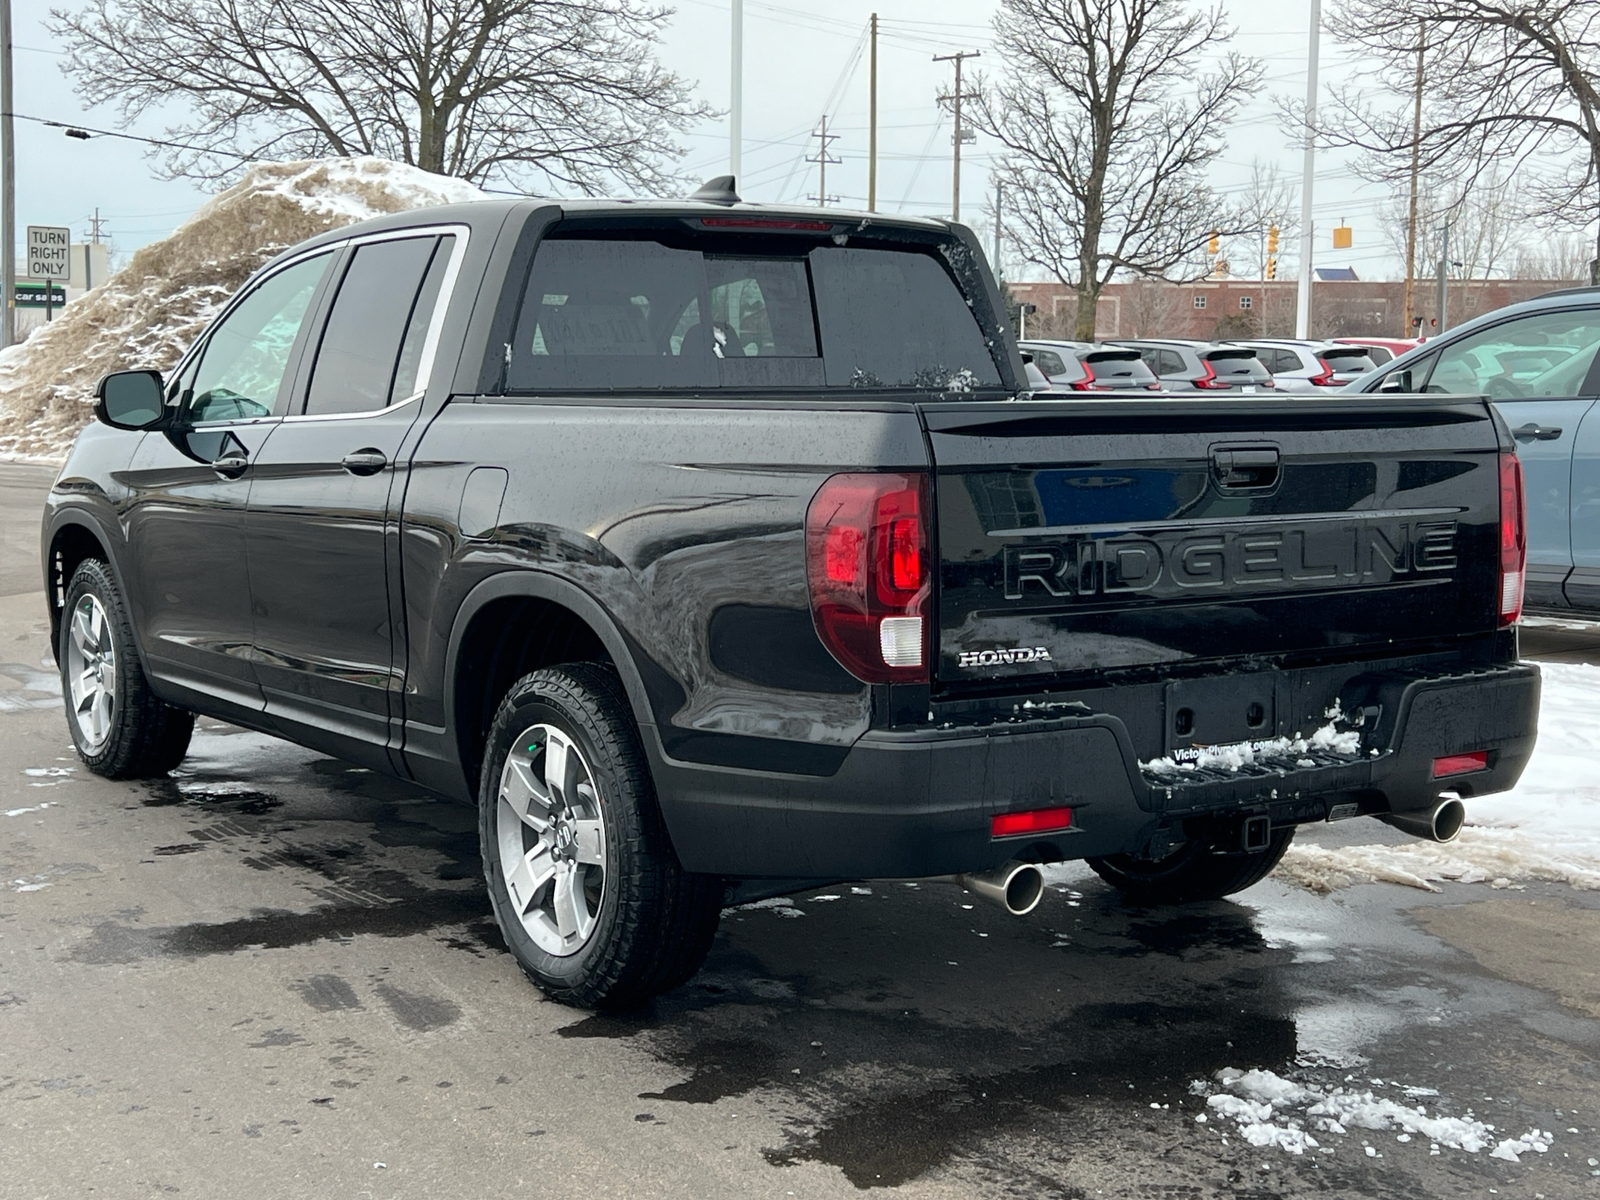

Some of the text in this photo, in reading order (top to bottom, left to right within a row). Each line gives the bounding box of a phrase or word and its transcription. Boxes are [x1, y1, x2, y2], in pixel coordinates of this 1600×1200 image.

[32, 231, 65, 245] TURN
[30, 246, 67, 260] RIGHT
[32, 261, 65, 275] ONLY
[15, 293, 64, 302] car saes
[1003, 519, 1457, 600] RIDGELINE
[958, 646, 1053, 668] HONDA
[1174, 740, 1274, 761] VictoPlym.com
